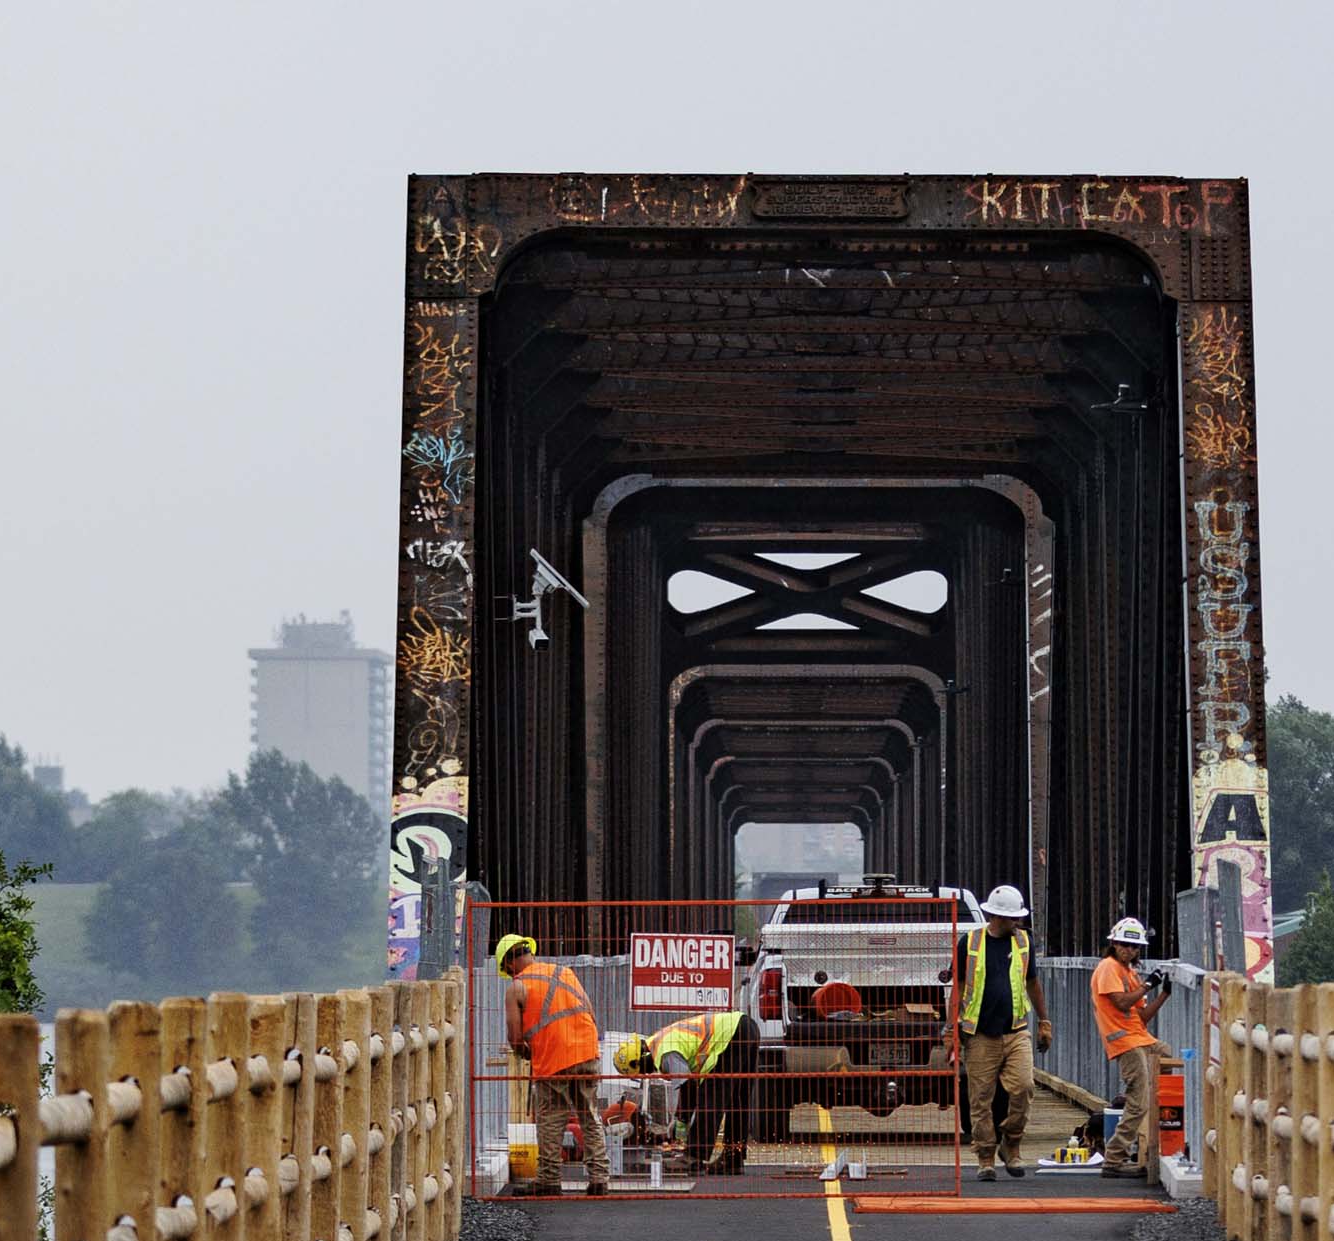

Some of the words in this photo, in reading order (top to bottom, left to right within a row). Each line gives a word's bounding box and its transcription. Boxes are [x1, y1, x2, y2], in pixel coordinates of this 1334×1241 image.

[634, 938, 730, 969] DANGER
[660, 971, 684, 984] DUE
[688, 972, 704, 984] TO
